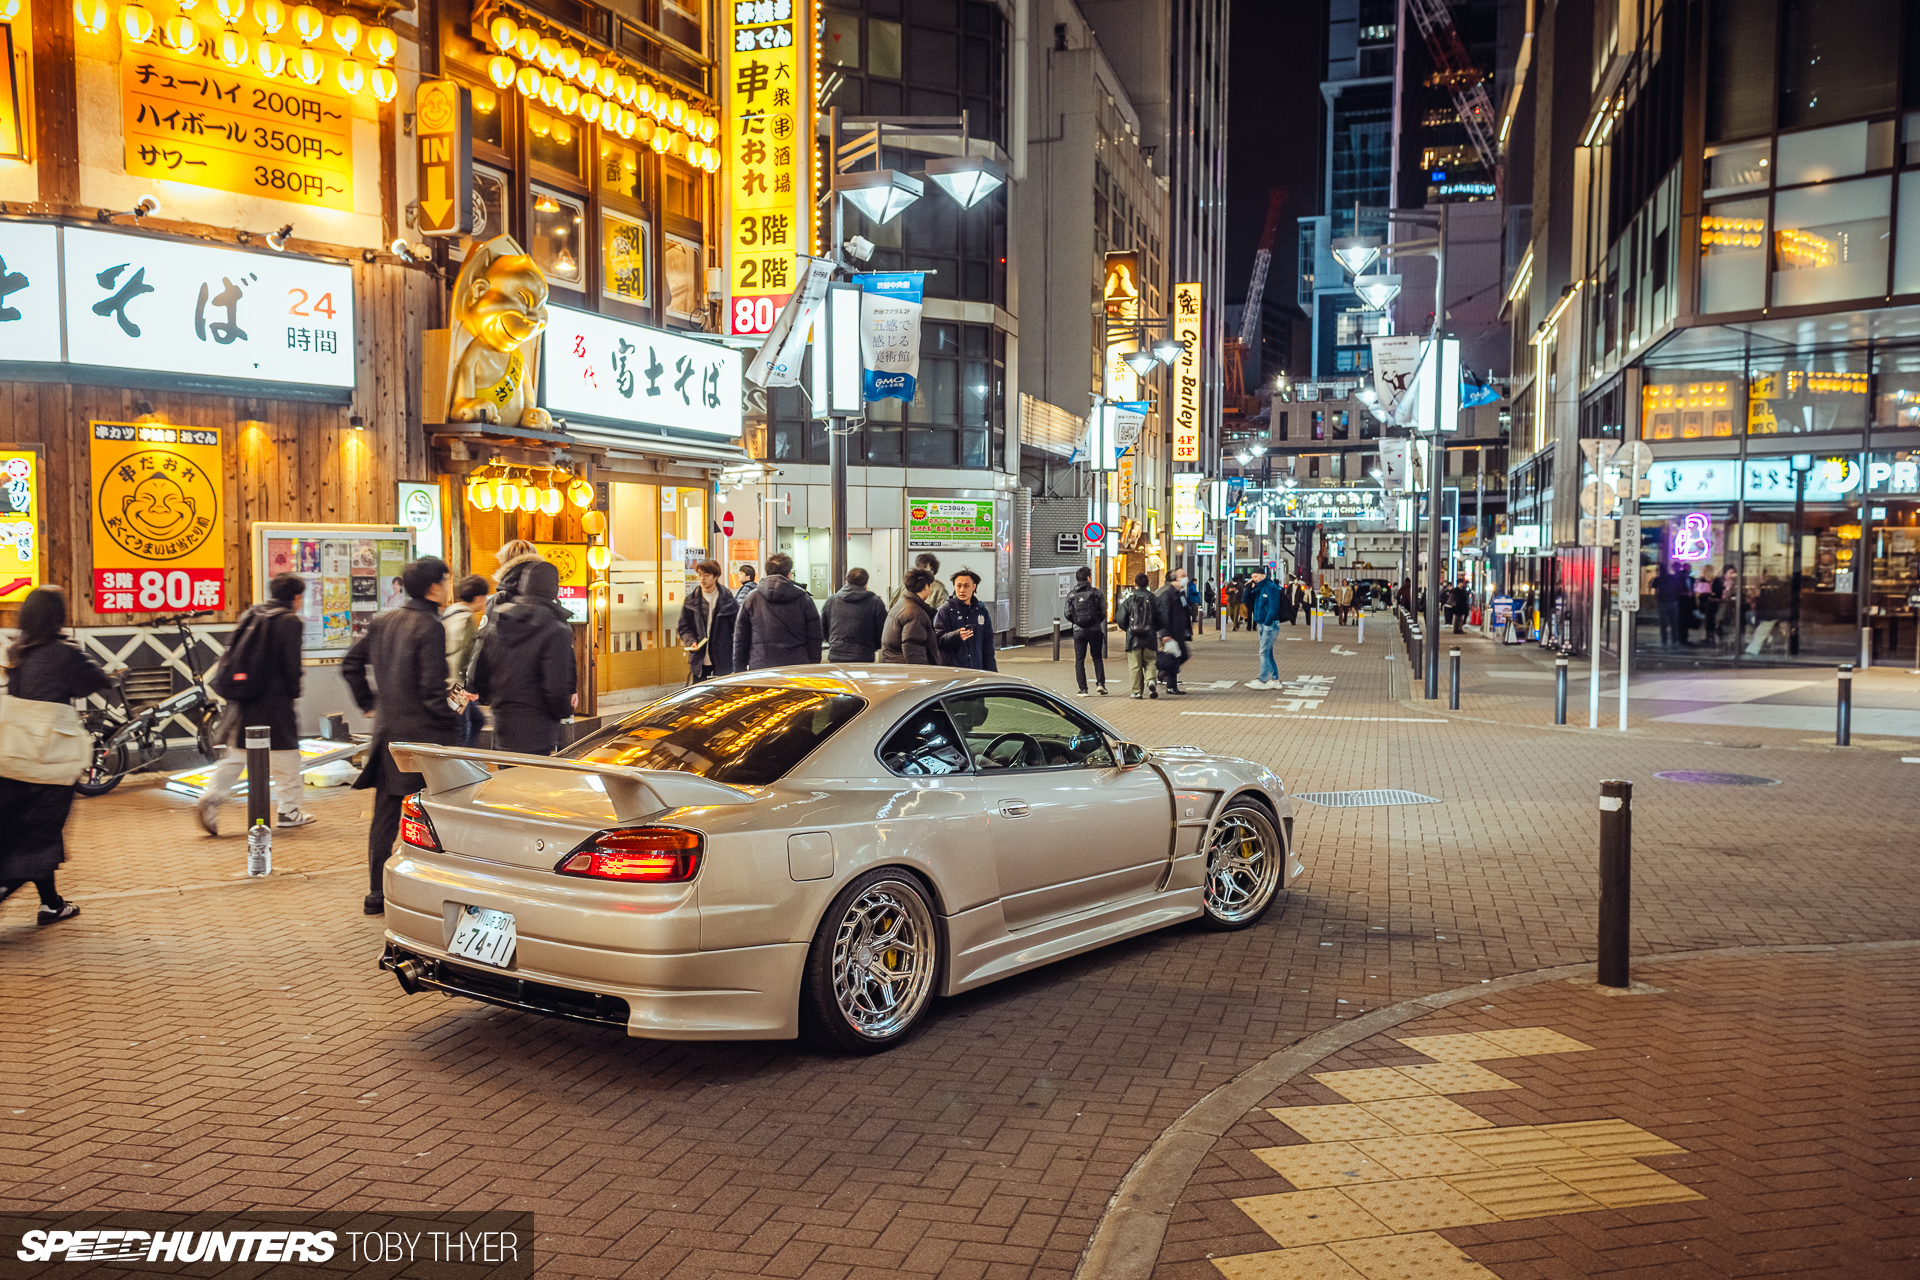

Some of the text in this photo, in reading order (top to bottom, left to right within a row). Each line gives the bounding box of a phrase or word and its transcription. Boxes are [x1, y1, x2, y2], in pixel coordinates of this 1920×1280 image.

[736, 25, 792, 51] おでん
[135, 63, 241, 104] チューハイ
[136, 103, 247, 142] ハイボール
[736, 59, 769, 198] 串だおれ
[137, 144, 207, 169] サワー
[422, 137, 450, 164] IN
[740, 213, 789, 246] 3階
[740, 257, 789, 289] 2階
[288, 288, 337, 320] 24
[735, 297, 786, 333] 80
[872, 318, 911, 332] 五感で
[287, 326, 337, 354] 時間
[872, 334, 909, 348] 感じる
[572, 334, 598, 389] 名代
[873, 350, 910, 363] 美術館
[611, 337, 725, 409] 富士そば
[875, 376, 905, 388] GMO
[1176, 328, 1198, 429] Corn-Barley
[95, 425, 136, 439] 串カツ
[180, 430, 217, 444] おでん
[1177, 435, 1195, 445] 4F
[1177, 447, 1195, 456] 3F
[118, 457, 195, 483] 串だおれ
[107, 516, 210, 556] 安くてうまいは当たり前
[1625, 519, 1636, 595] この先行き止まり
[102, 572, 134, 589] 3階
[139, 570, 221, 609] 80席
[102, 592, 134, 609] 2階
[493, 916, 511, 931] 301
[456, 927, 513, 962] と 74-11
